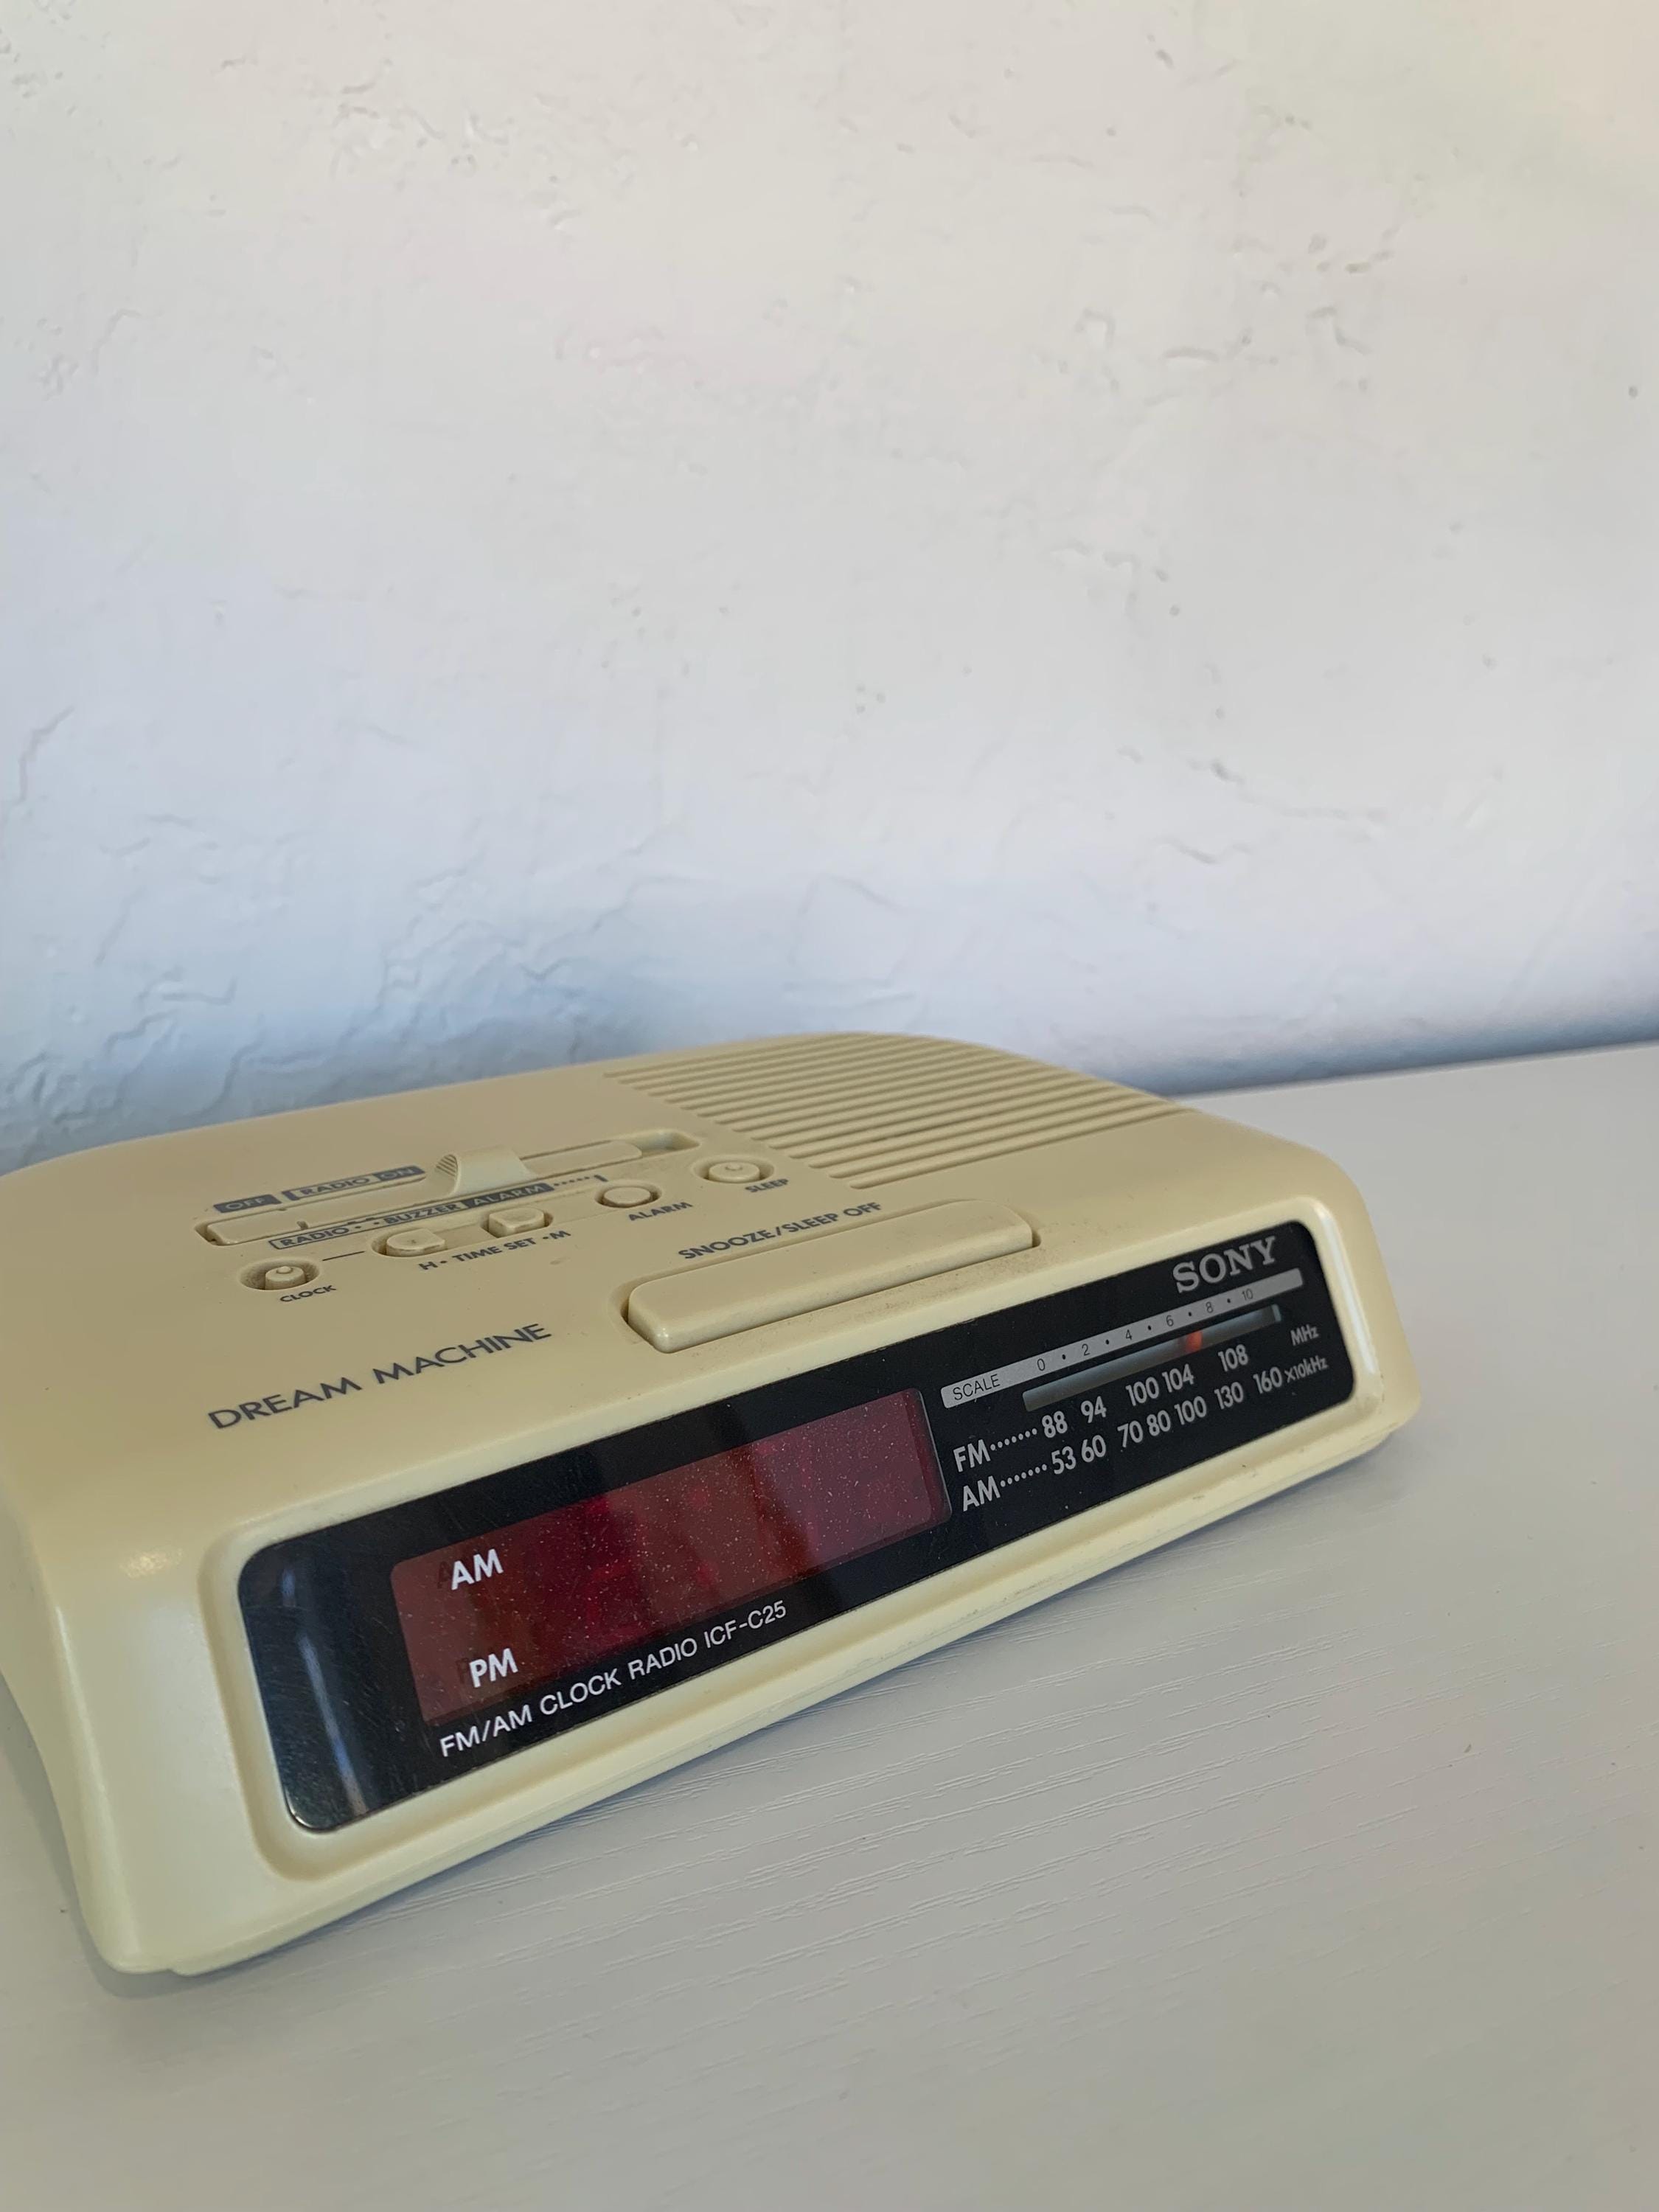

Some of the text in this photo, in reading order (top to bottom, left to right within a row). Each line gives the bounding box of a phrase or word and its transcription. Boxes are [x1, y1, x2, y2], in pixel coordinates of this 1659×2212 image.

[299, 1166, 415, 1196] RADIO ON
[745, 1178, 790, 1193] SLEEP
[226, 1197, 268, 1211] OFF
[280, 1183, 546, 1247] RADIO BUZZER ALARM
[628, 1202, 693, 1222] ALARM
[843, 1202, 883, 1217] OFF
[452, 1245, 502, 1262] TIME
[504, 1237, 537, 1252] SET
[1172, 1236, 1277, 1293] SONY
[279, 1284, 336, 1303] CLOCK
[953, 1288, 1253, 1400] SCALE 0 2 4 6 8 10
[208, 1324, 552, 1429] DREAM MACHINE
[953, 1325, 1319, 1472] FM 88 94 100 104 108 MHz
[961, 1475, 1001, 1512] AM
[1051, 1447, 1076, 1475] 53
[1081, 1435, 1106, 1463] 60
[1118, 1420, 1144, 1448] 70
[1146, 1411, 1172, 1437] 80
[1174, 1397, 1207, 1425] 100
[1214, 1382, 1244, 1410] 130
[1253, 1367, 1282, 1395] 160
[451, 1548, 504, 1590] AM
[439, 1600, 787, 1758] FM/AM CLOCK RADIO ICF-C25
[469, 1647, 518, 1688] PM
